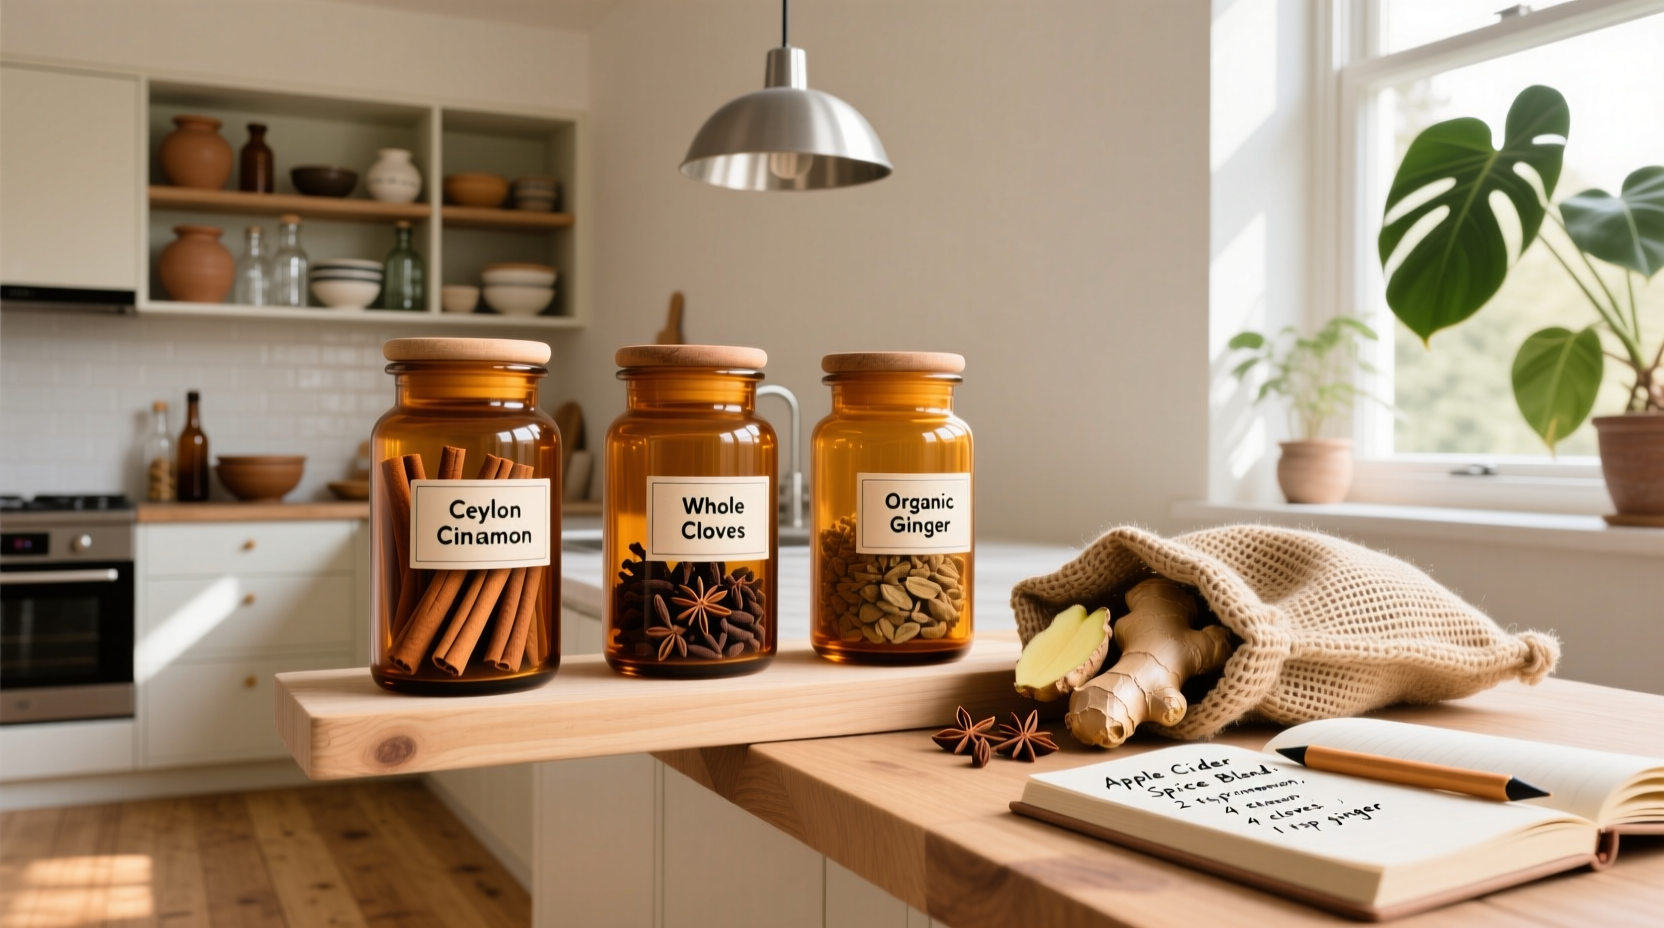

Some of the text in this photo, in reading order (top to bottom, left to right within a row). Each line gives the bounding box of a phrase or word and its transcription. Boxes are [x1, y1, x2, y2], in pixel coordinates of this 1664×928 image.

[449, 498, 521, 524] Ceylon
[682, 496, 745, 514] Whole
[885, 492, 954, 515] Organic
[437, 525, 532, 545] Cinamon
[681, 521, 746, 540] Cloves
[890, 516, 951, 538] Ginger
[1105, 758, 1230, 790] Apple Cider
[1147, 781, 1210, 800] Spice
[1174, 800, 1192, 810] 2
